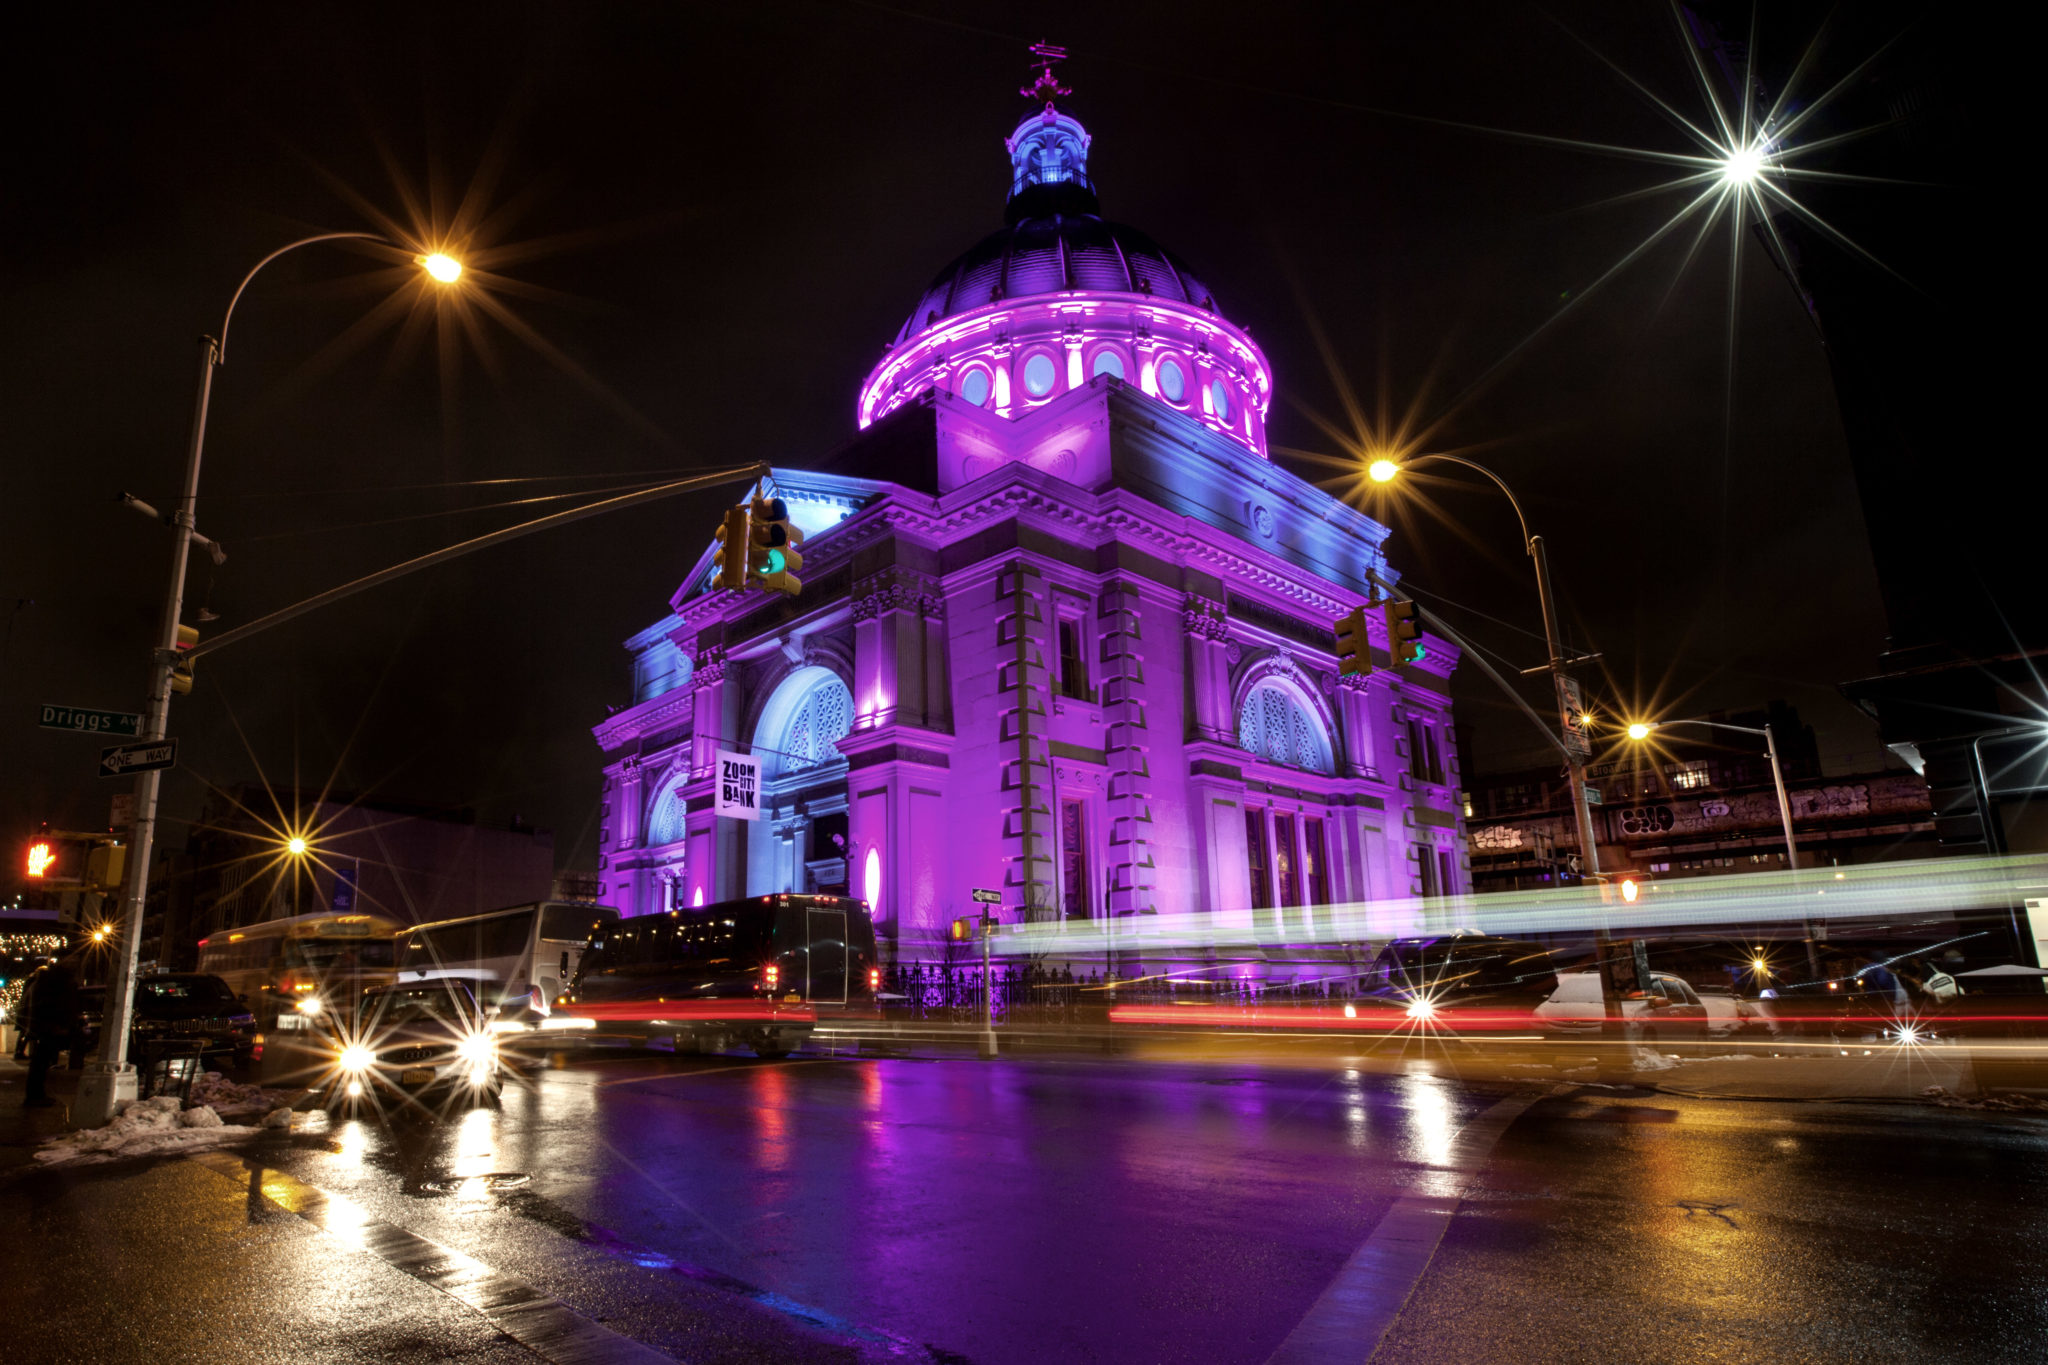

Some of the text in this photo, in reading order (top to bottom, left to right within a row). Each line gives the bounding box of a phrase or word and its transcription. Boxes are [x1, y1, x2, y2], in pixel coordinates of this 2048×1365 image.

[43, 707, 112, 731] Driggs
[108, 748, 169, 767] ONE WAY
[723, 760, 755, 778] ZOOM
[740, 777, 755, 790] CITY
[723, 784, 755, 808] BANK
